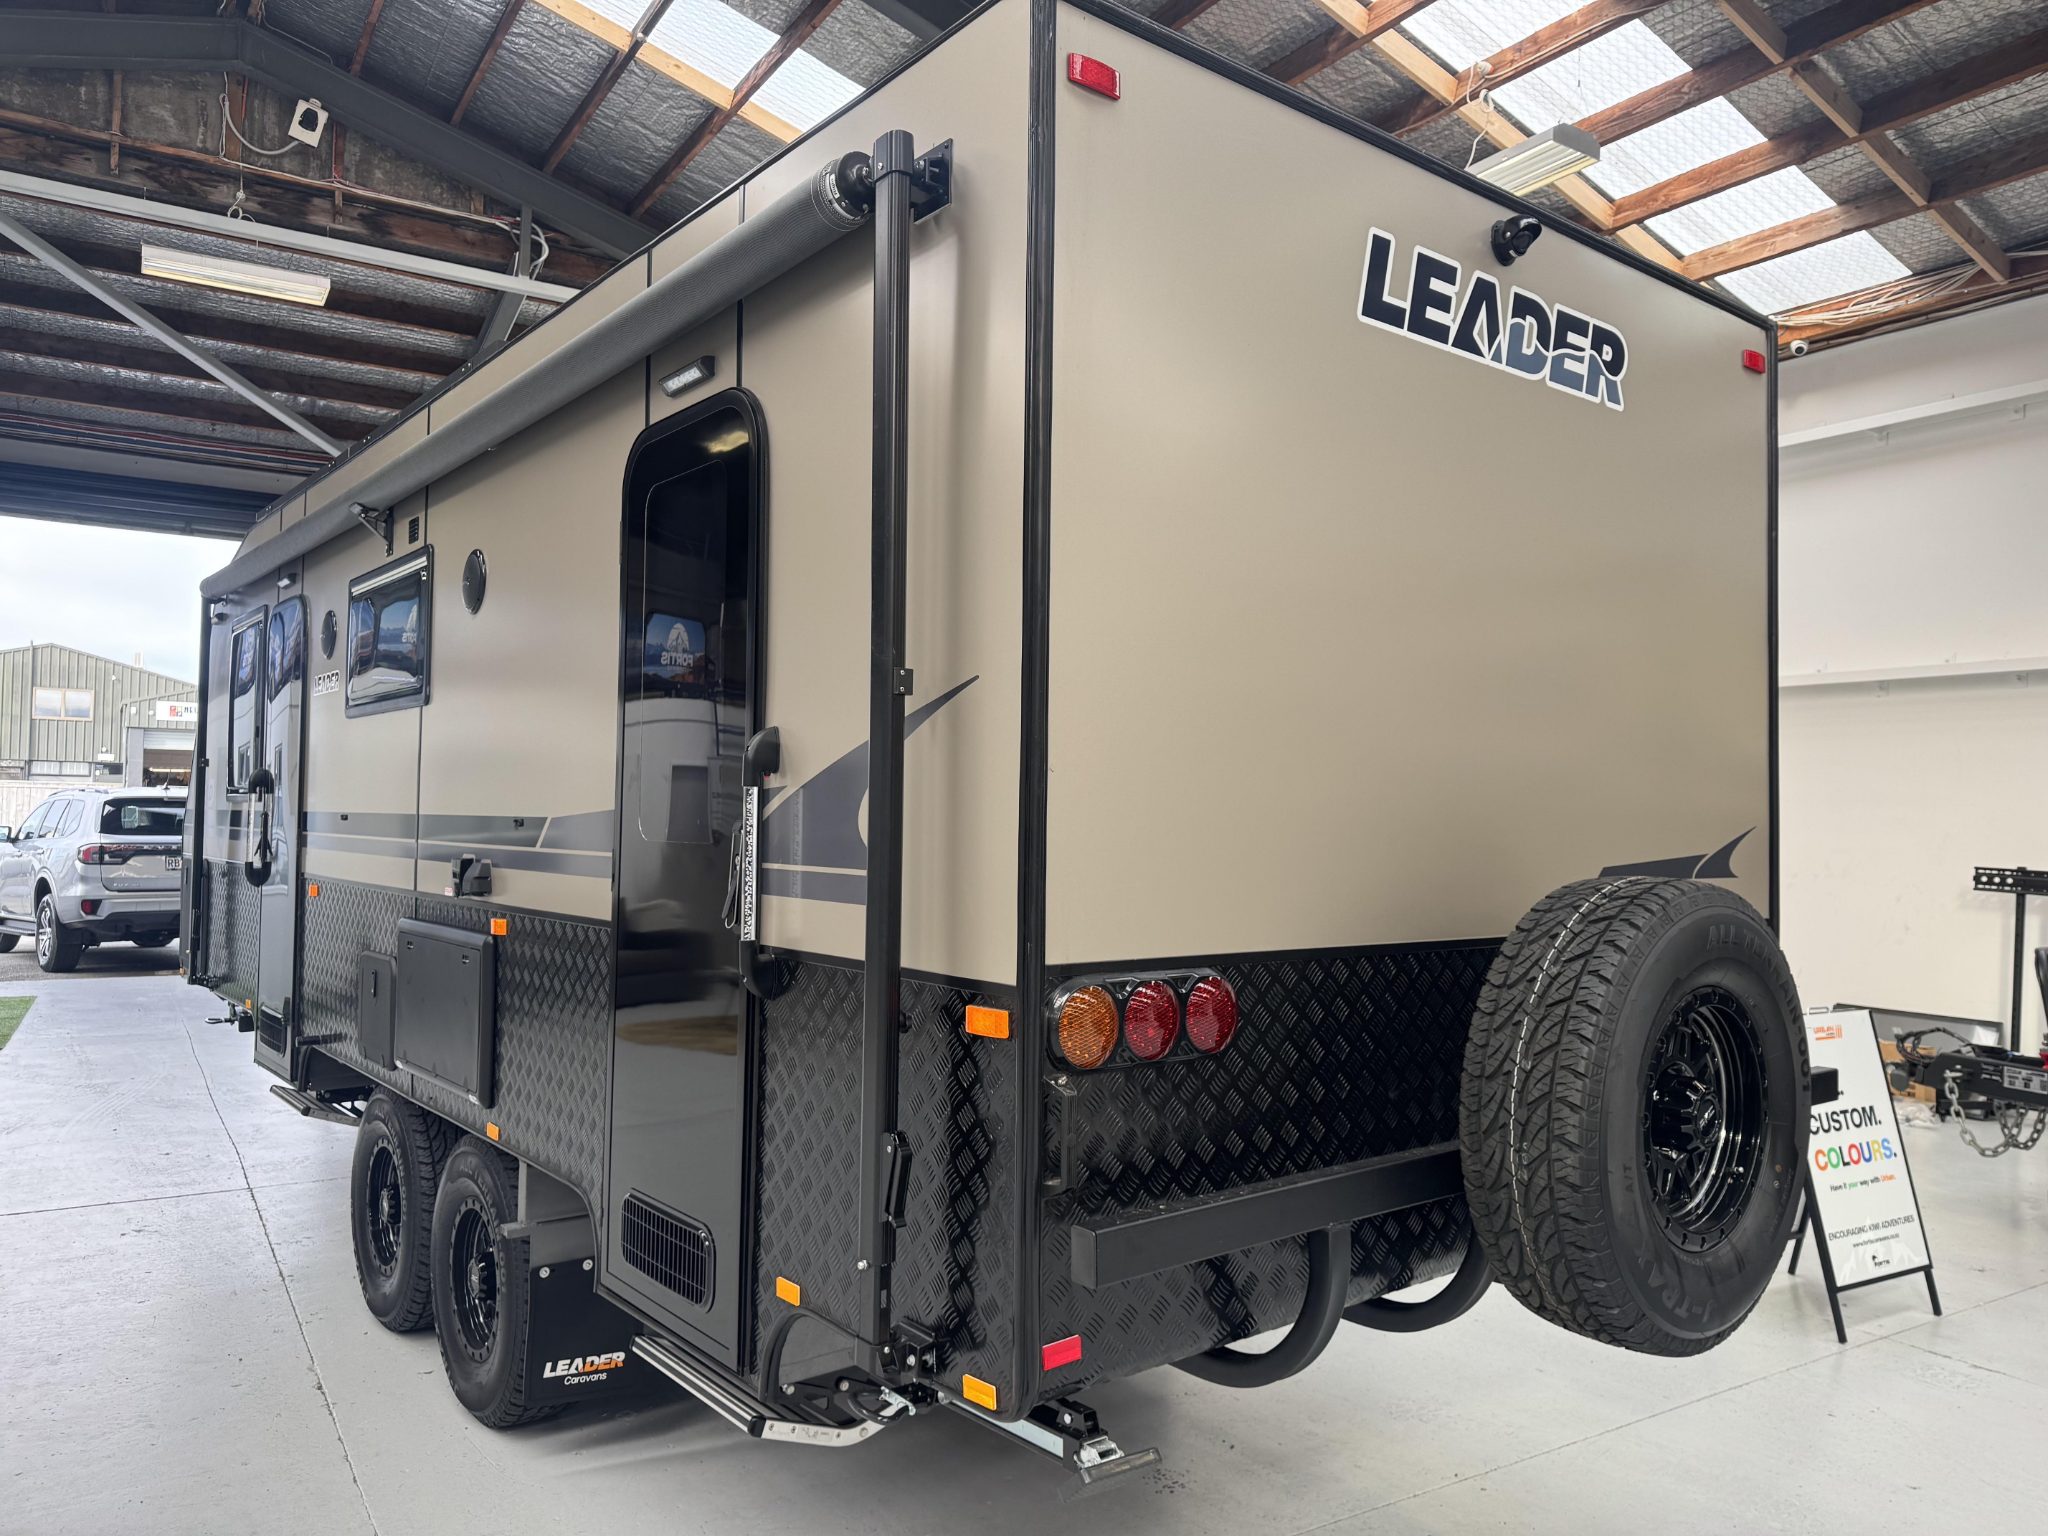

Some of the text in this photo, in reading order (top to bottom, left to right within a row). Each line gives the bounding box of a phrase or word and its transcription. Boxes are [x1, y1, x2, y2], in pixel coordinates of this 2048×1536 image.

[1357, 226, 1628, 412] LEADER
[313, 670, 340, 696] LEADER
[1706, 924, 1739, 952] ALL
[1809, 1105, 1882, 1135] CUSTOM.
[1814, 1137, 1897, 1171] COLOURS.
[1828, 1214, 1915, 1241] ENCOURAGING KIWI ADVENTURES
[543, 1351, 626, 1378] LEADER
[564, 1371, 607, 1386] Caravans
